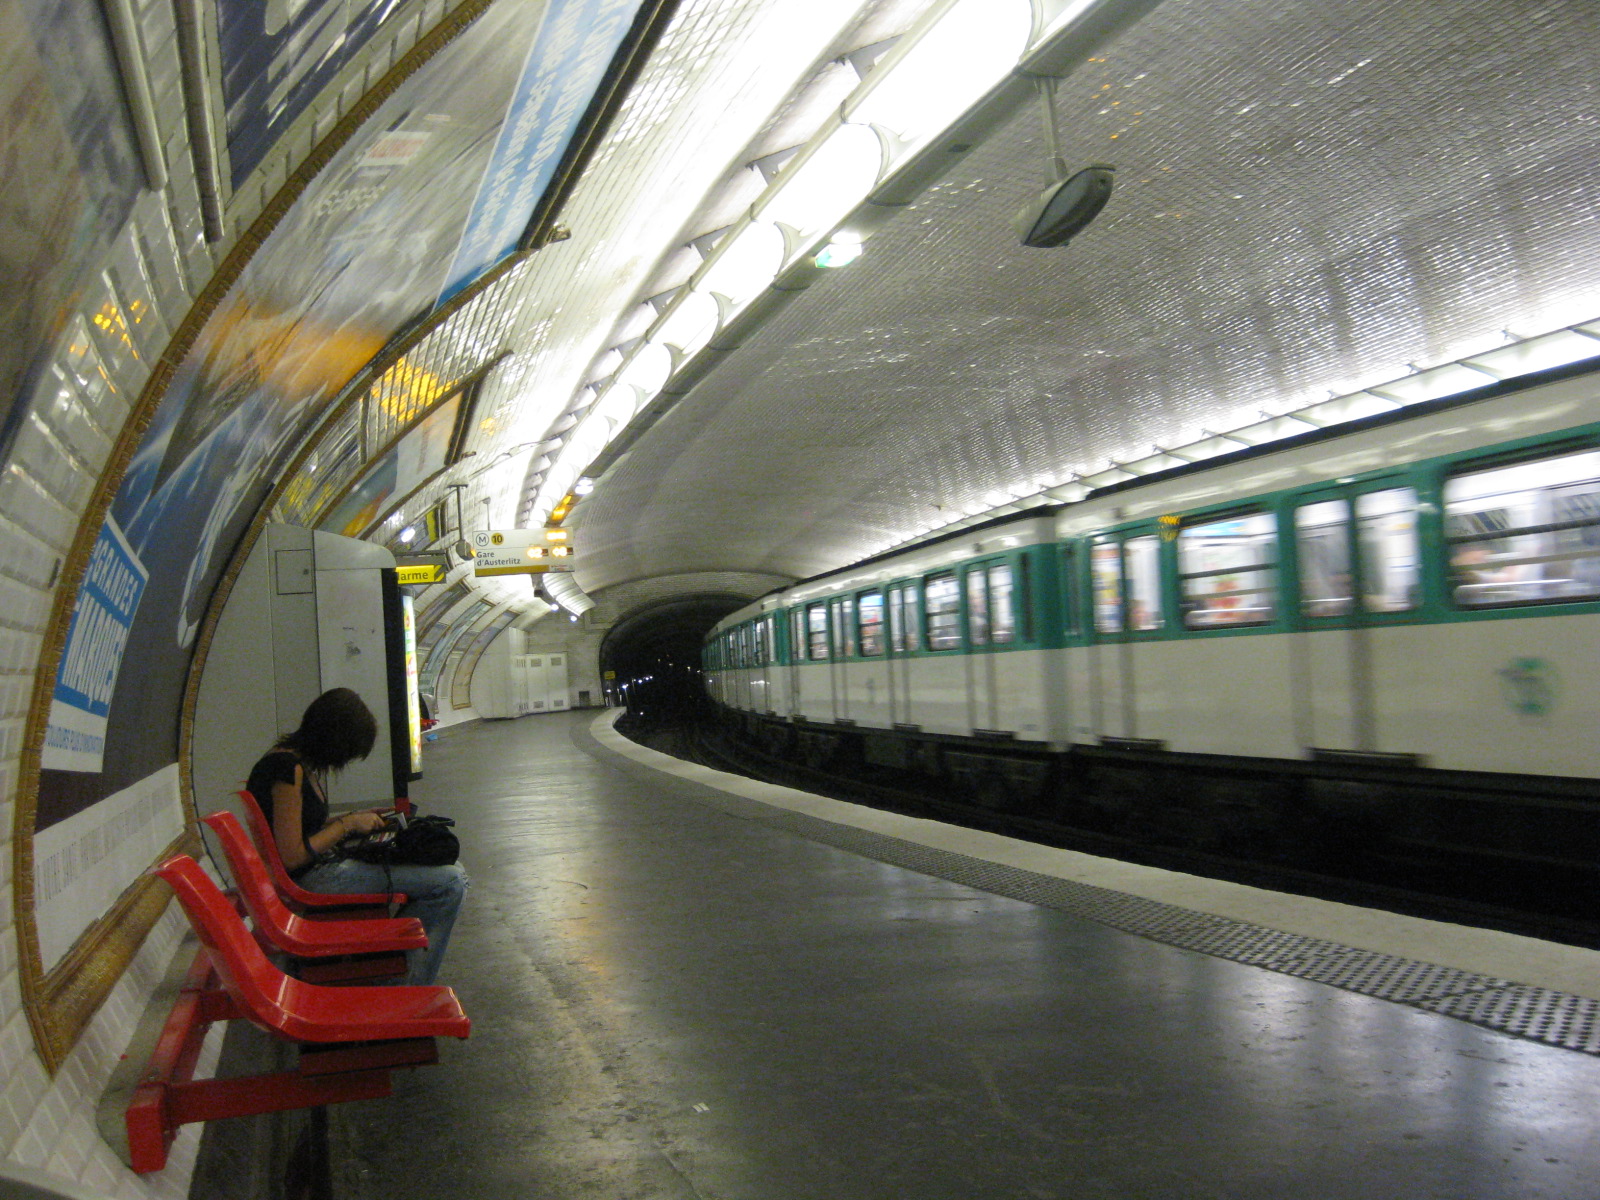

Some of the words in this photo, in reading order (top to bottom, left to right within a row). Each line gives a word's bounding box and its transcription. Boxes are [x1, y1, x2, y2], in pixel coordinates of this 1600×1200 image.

[492, 535, 503, 543] 10
[92, 540, 138, 616] GRANDES
[477, 558, 520, 566] d'Austerlitz
[62, 592, 127, 709] MARQUES
